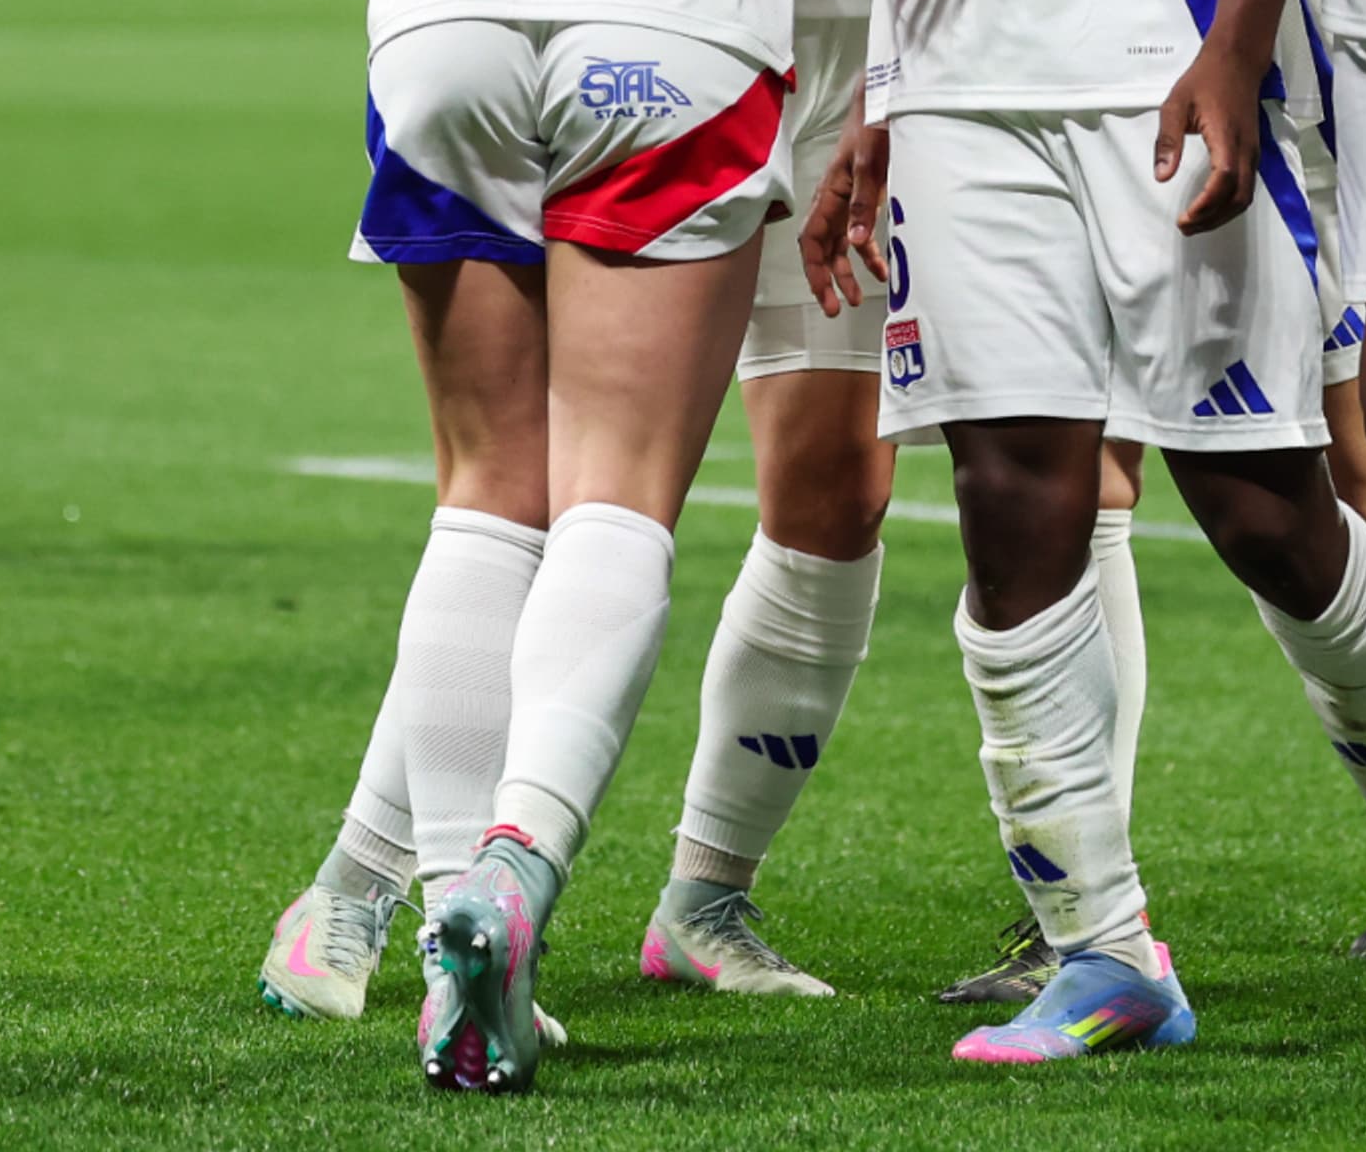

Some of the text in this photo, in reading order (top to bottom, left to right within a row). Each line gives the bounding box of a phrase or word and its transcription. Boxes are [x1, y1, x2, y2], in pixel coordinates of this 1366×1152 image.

[595, 106, 677, 120] STAL T.P.
[890, 348, 923, 379] OL
